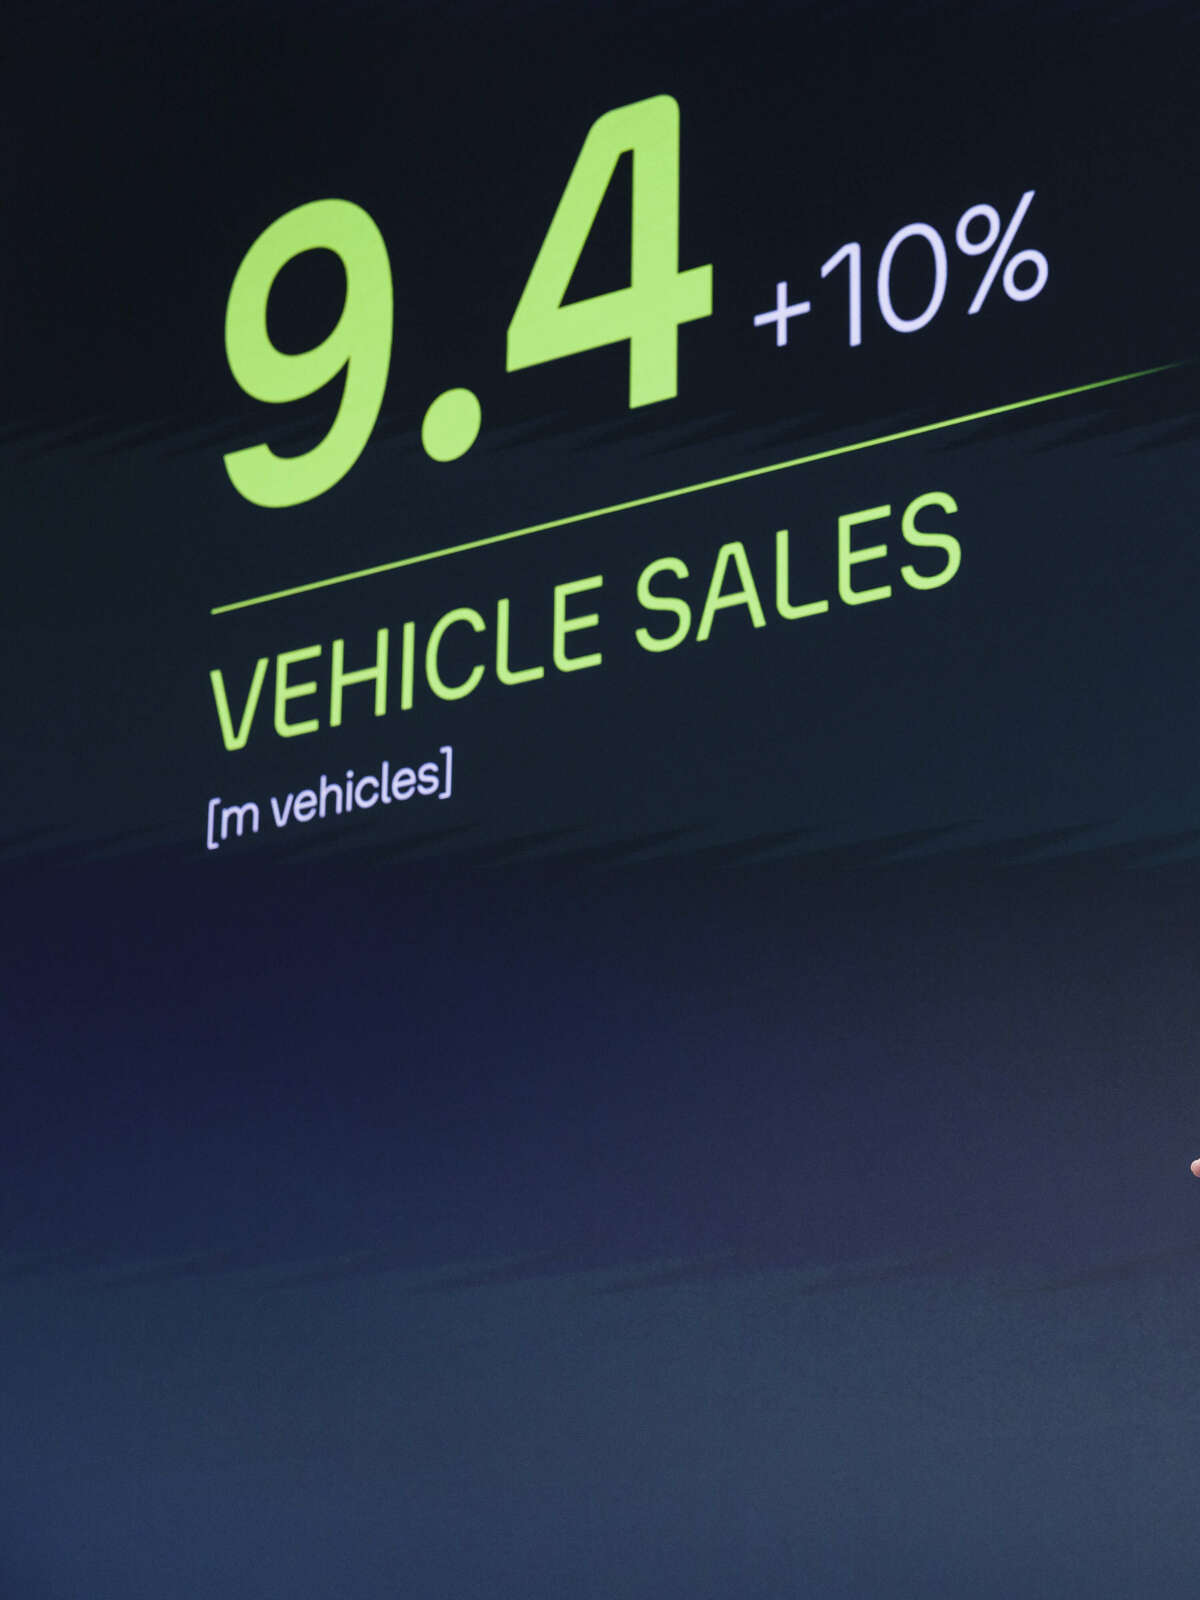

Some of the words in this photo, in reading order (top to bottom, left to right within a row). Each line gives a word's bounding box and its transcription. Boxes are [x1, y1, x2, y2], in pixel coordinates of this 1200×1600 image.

[223, 94, 714, 509] 9.4
[752, 189, 1050, 348] +10%
[208, 573, 606, 752] VEHICLE
[635, 490, 963, 653] SALES
[206, 797, 260, 850] [m
[270, 745, 453, 828] vehicles]
